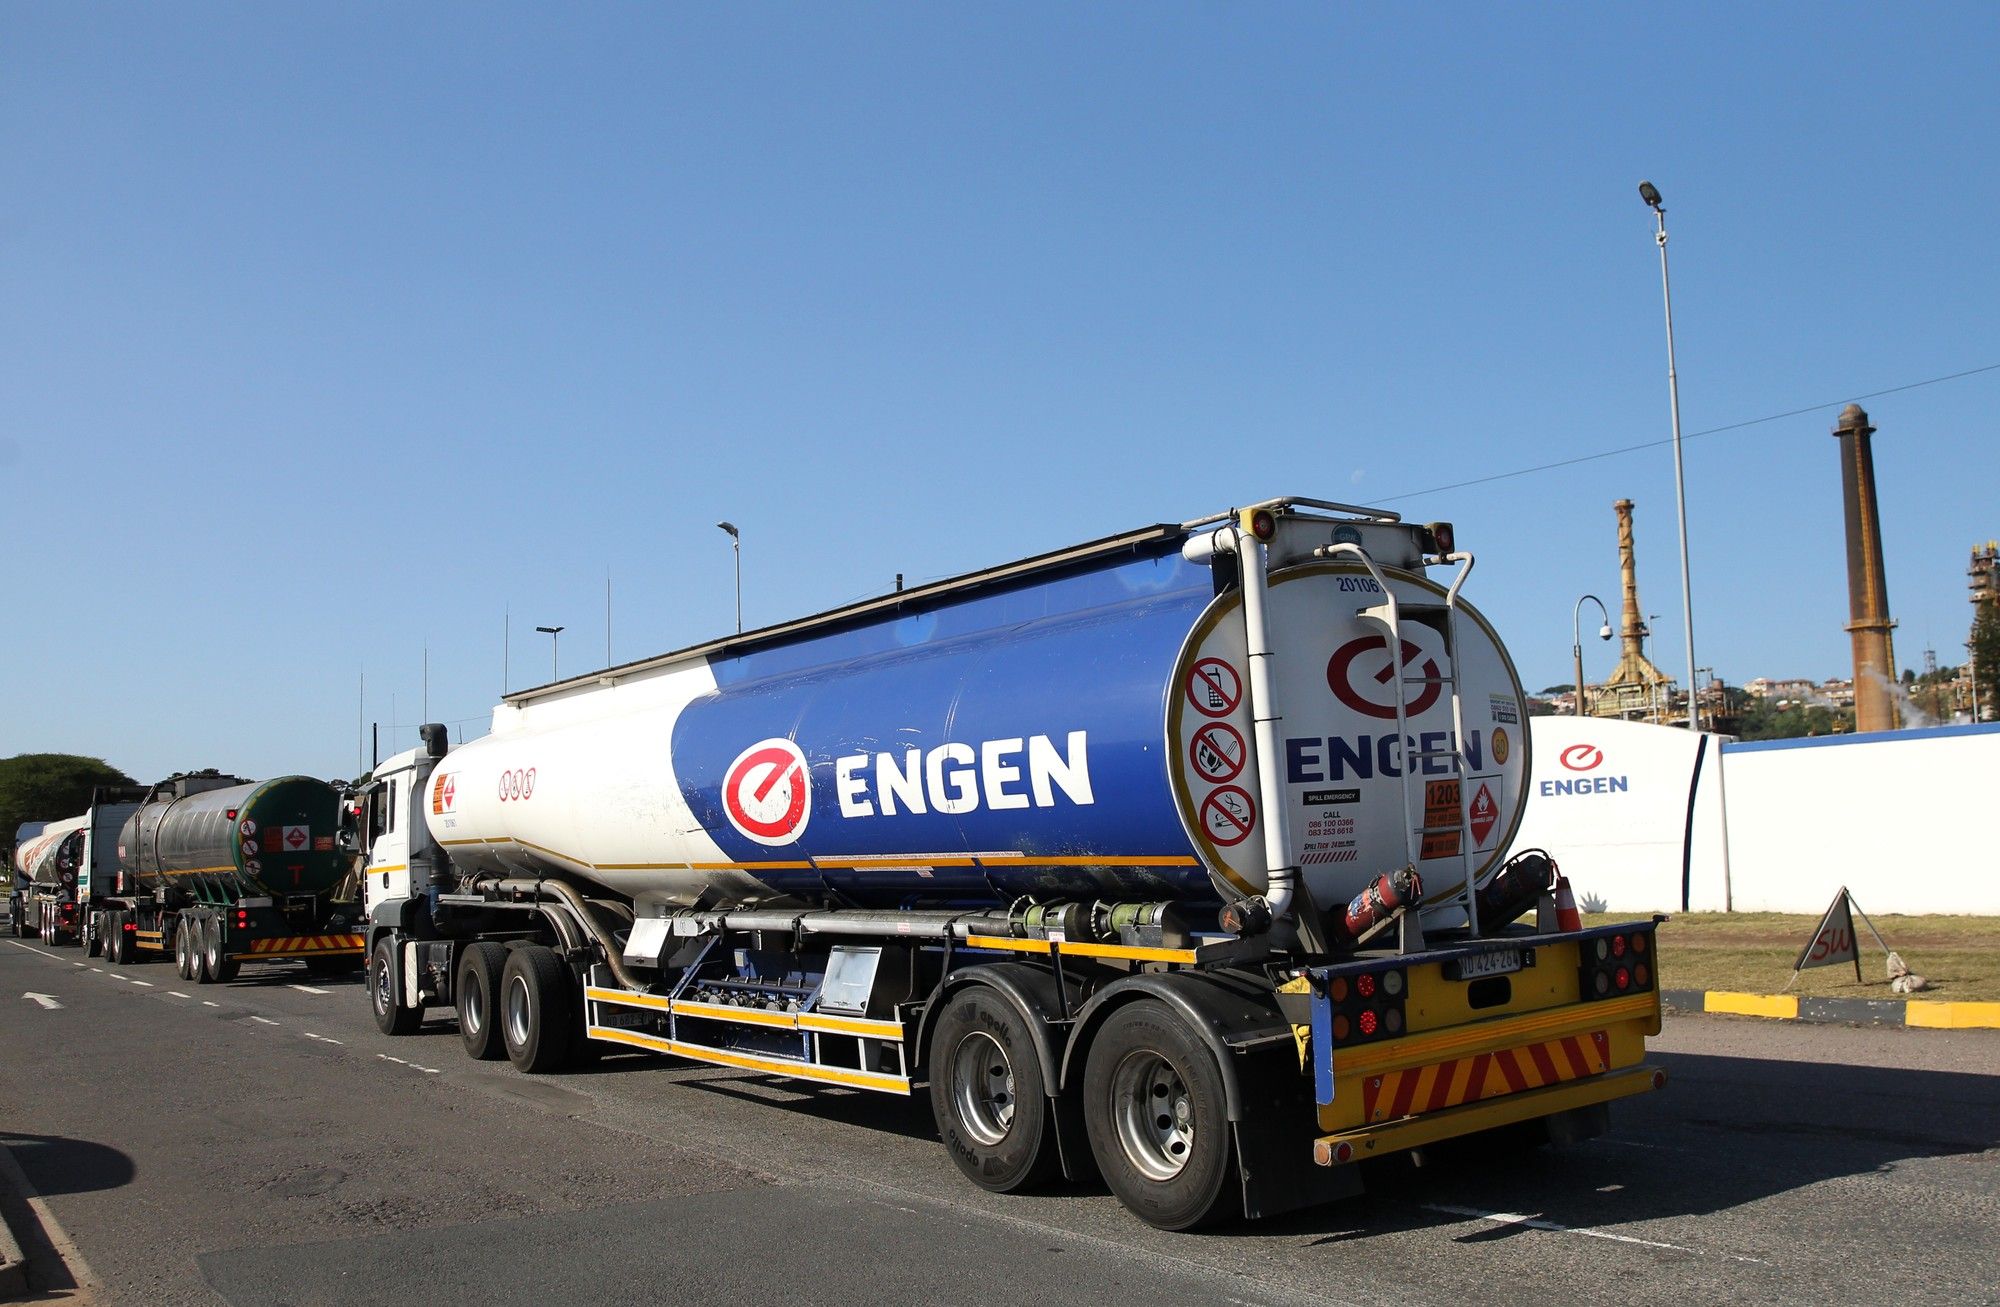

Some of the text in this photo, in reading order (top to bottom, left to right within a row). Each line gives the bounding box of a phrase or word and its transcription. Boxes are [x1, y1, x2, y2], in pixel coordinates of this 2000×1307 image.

[1286, 729, 1483, 784] ENGEN
[836, 730, 1095, 818] ENGEN
[1324, 792, 1356, 801] EMERGENCY
[1429, 783, 1460, 806] 1203
[1540, 775, 1628, 797] ENGEN
[1308, 820, 1321, 828] 086
[1324, 819, 1336, 827] 100
[1323, 811, 1341, 819] CALL
[1308, 829, 1321, 837] 083
[1323, 828, 1336, 836] 253
[979, 1011, 1012, 1049] apollo
[949, 1128, 980, 1168] apollo
